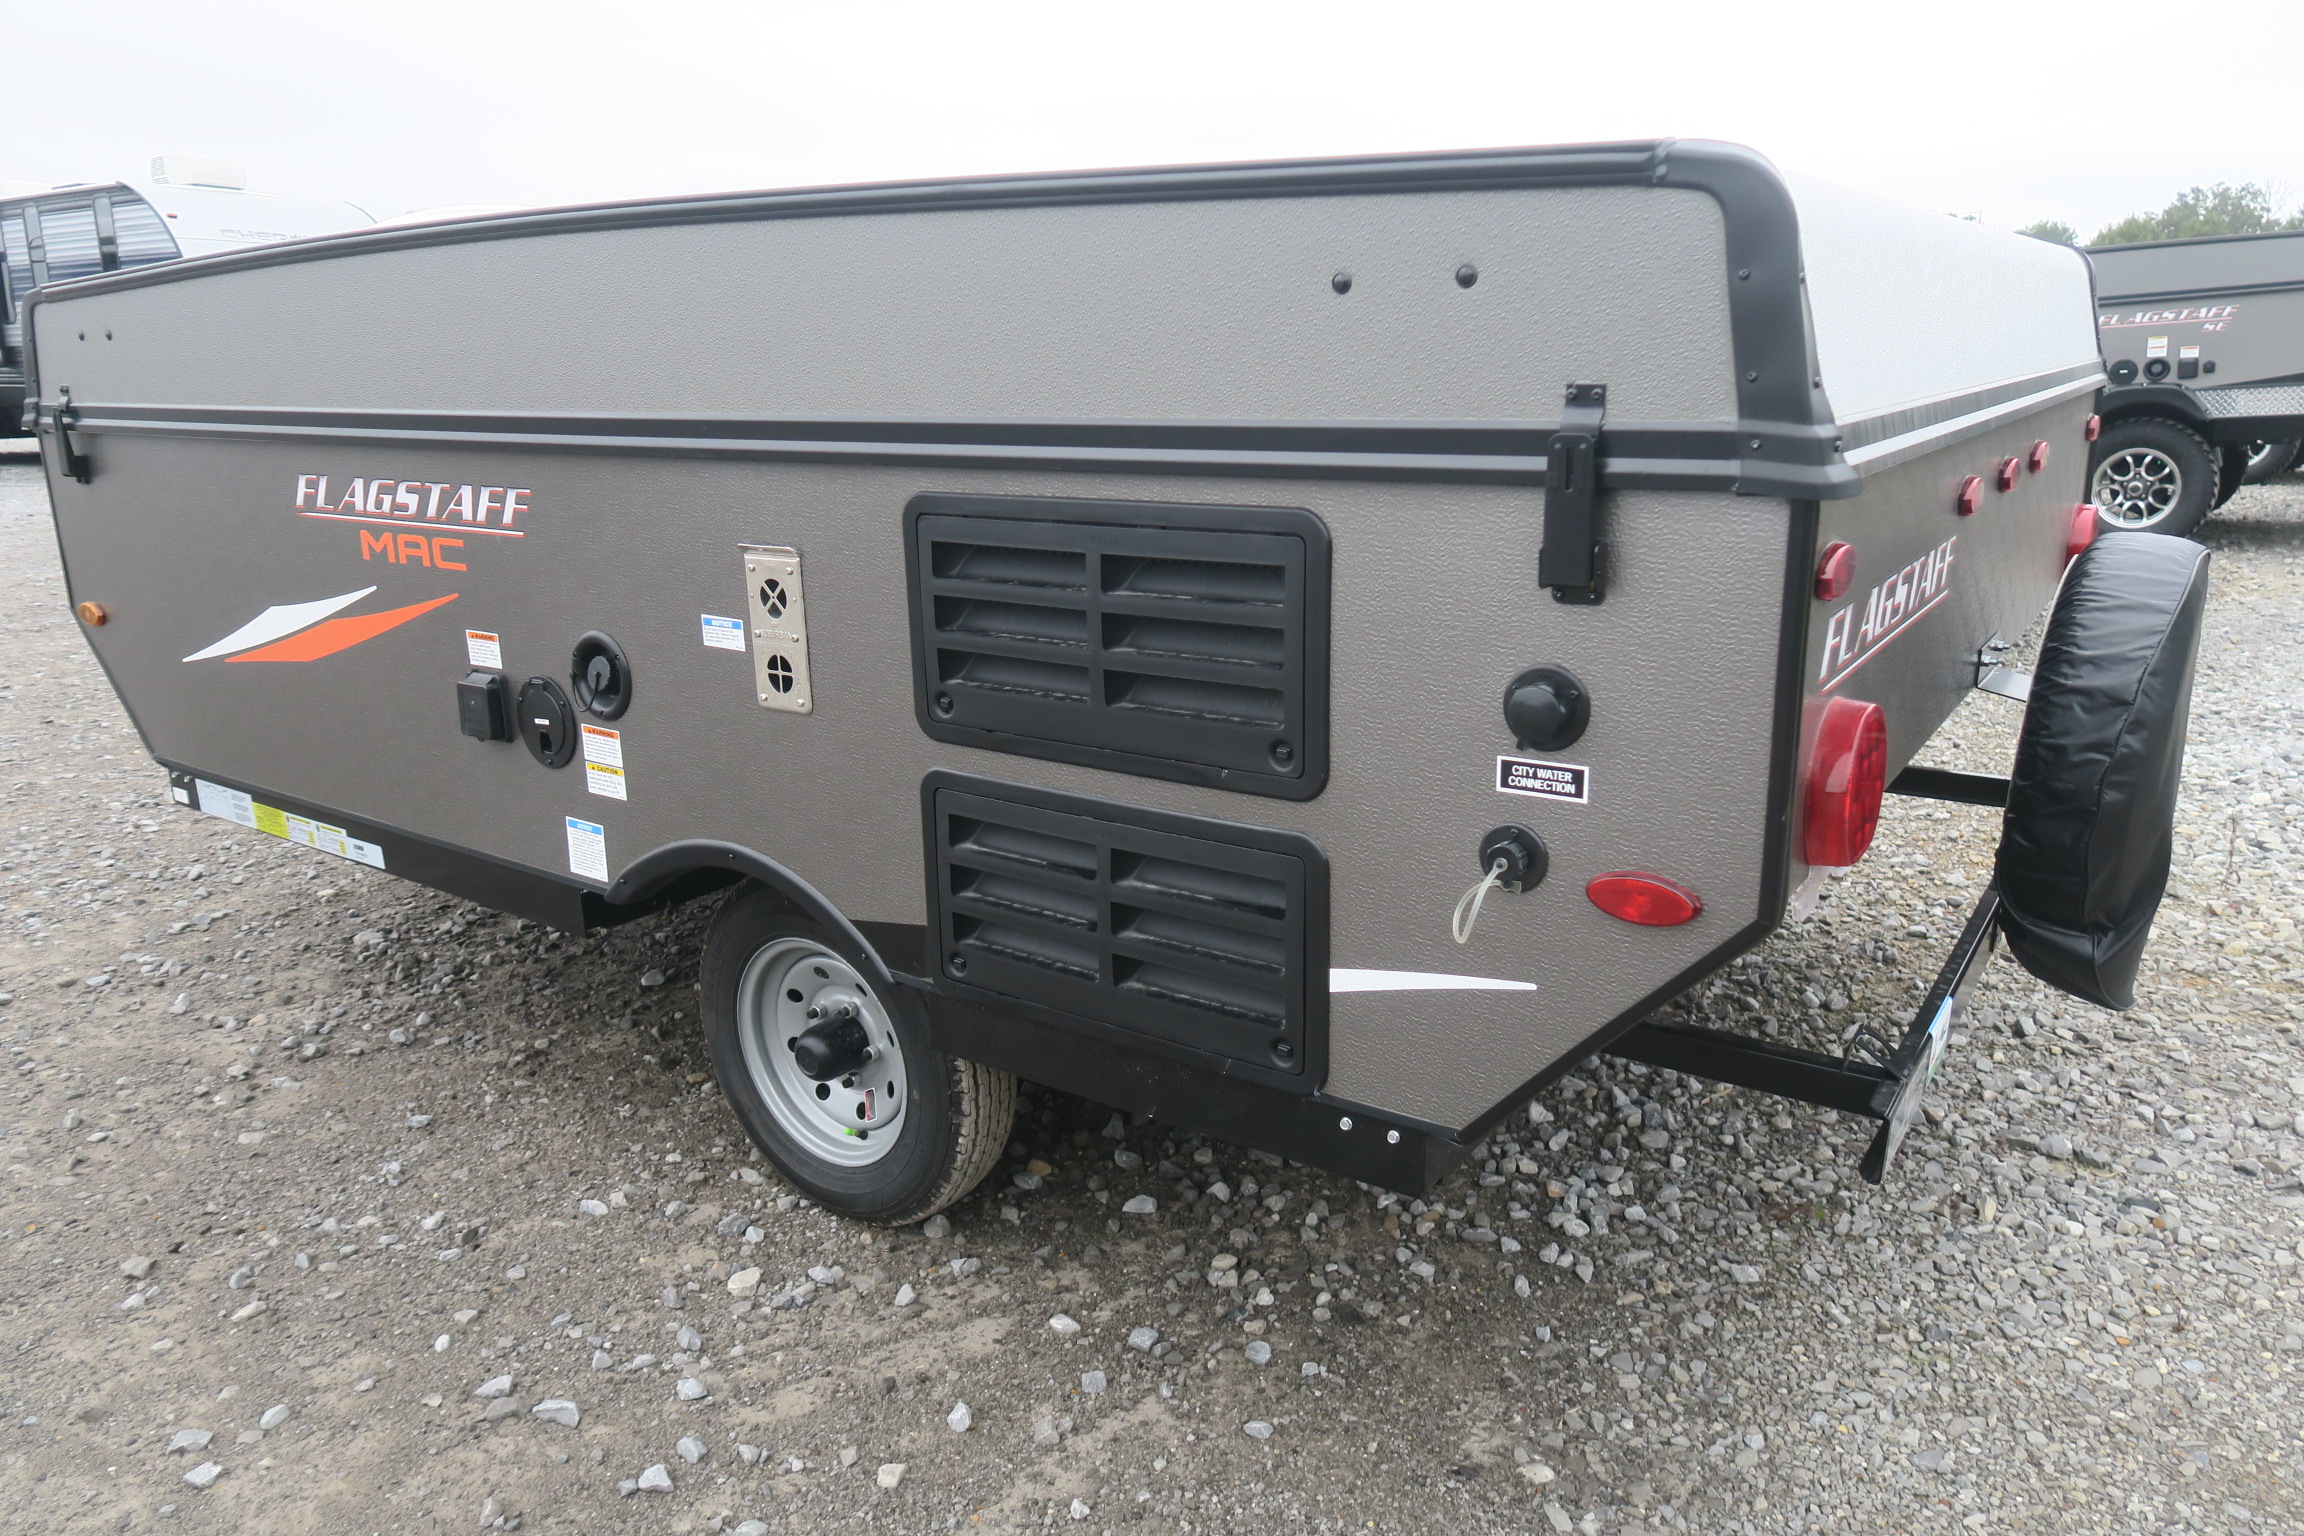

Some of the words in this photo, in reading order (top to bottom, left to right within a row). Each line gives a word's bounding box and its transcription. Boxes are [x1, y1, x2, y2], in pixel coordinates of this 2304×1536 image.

[2098, 304, 2240, 327] FLAGSTAFF
[2201, 321, 2229, 333] SE
[295, 473, 532, 527] FLAGSTAFF
[359, 529, 467, 572] MAC
[1818, 535, 1958, 684] FLAGSTAFF
[711, 619, 733, 628] NOTICE
[595, 764, 618, 775] CAUTION
[1511, 764, 1535, 777] CITY
[1536, 768, 1573, 783] WATER
[1508, 775, 1576, 794] CONNECTION
[576, 822, 593, 832] NOTICE
